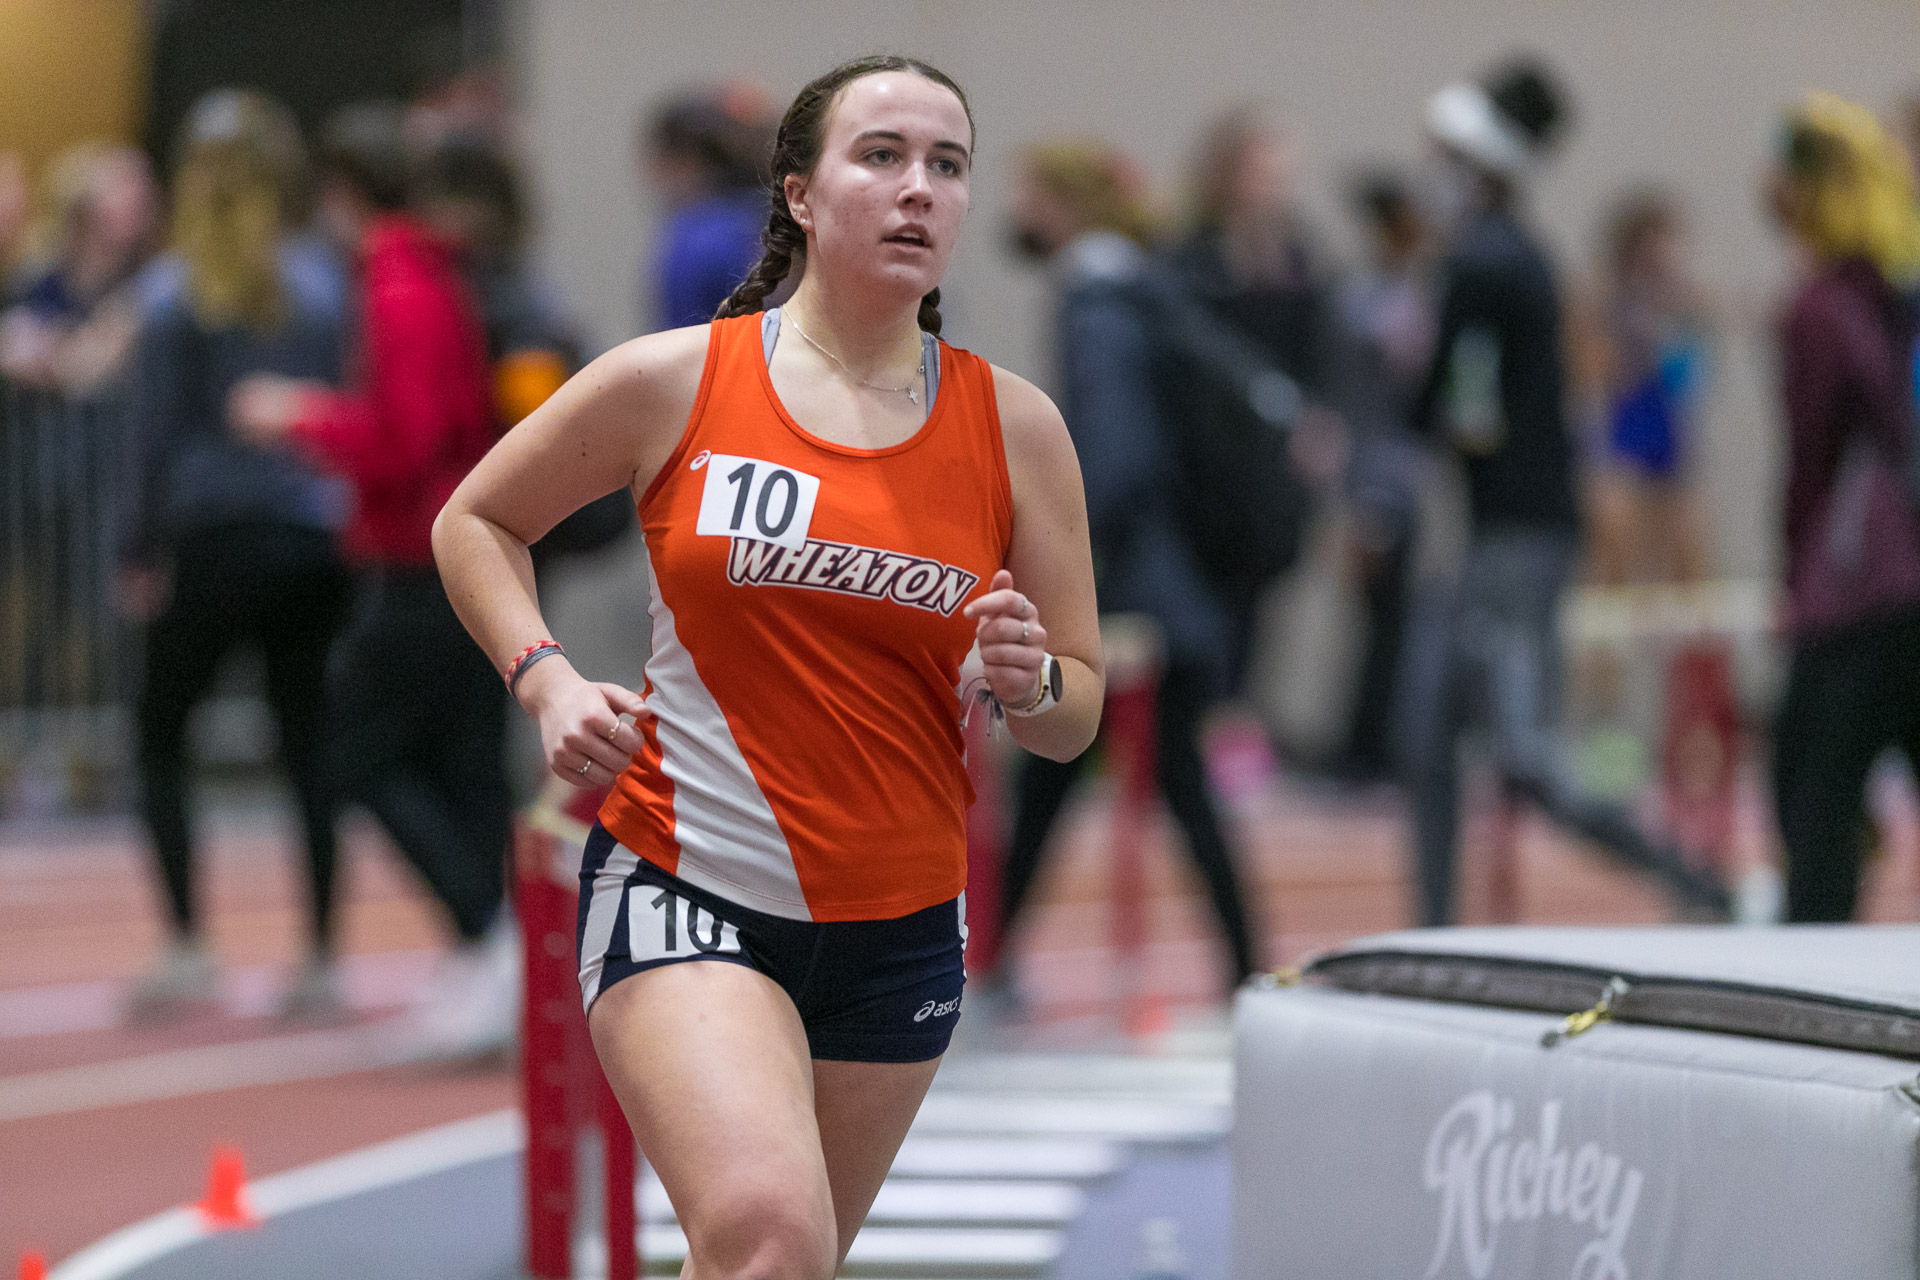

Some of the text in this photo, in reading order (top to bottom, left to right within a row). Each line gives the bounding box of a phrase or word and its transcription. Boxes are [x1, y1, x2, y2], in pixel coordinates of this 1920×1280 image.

[727, 462, 799, 537] 10
[727, 536, 980, 618] WHEATON
[651, 889, 724, 952] 10
[1423, 1089, 1643, 1280] Richey
